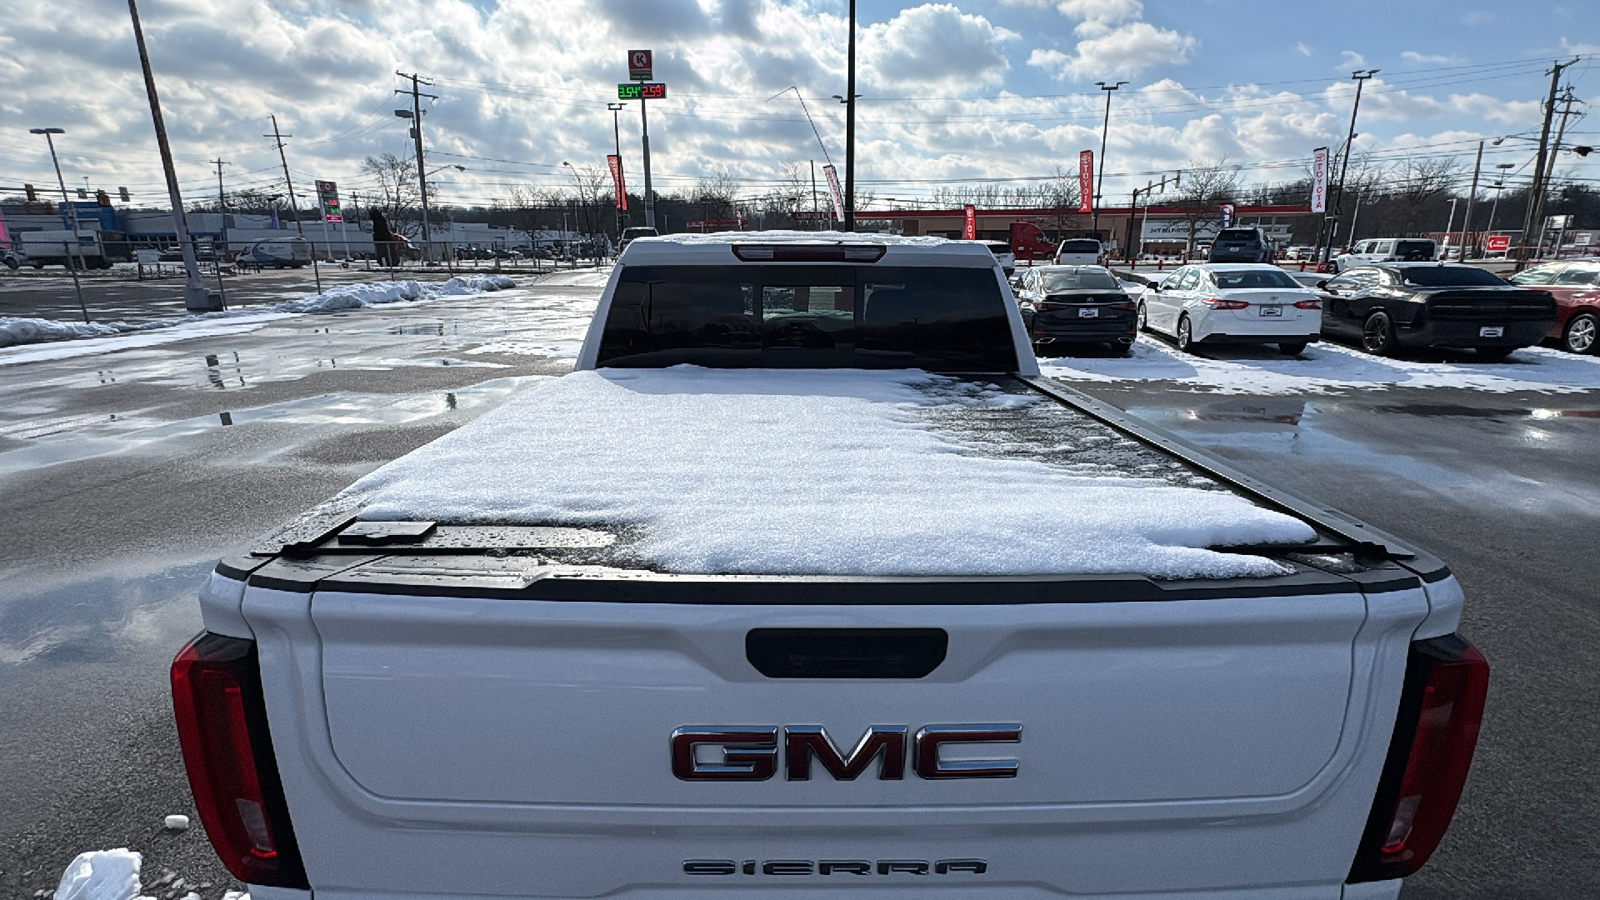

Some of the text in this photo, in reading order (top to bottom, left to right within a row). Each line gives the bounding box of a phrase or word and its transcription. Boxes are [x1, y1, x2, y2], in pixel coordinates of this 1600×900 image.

[636, 54, 646, 66] K
[1315, 163, 1324, 209] TOYOTA
[670, 723, 1023, 781] GMC
[682, 858, 988, 876] SIERRA
